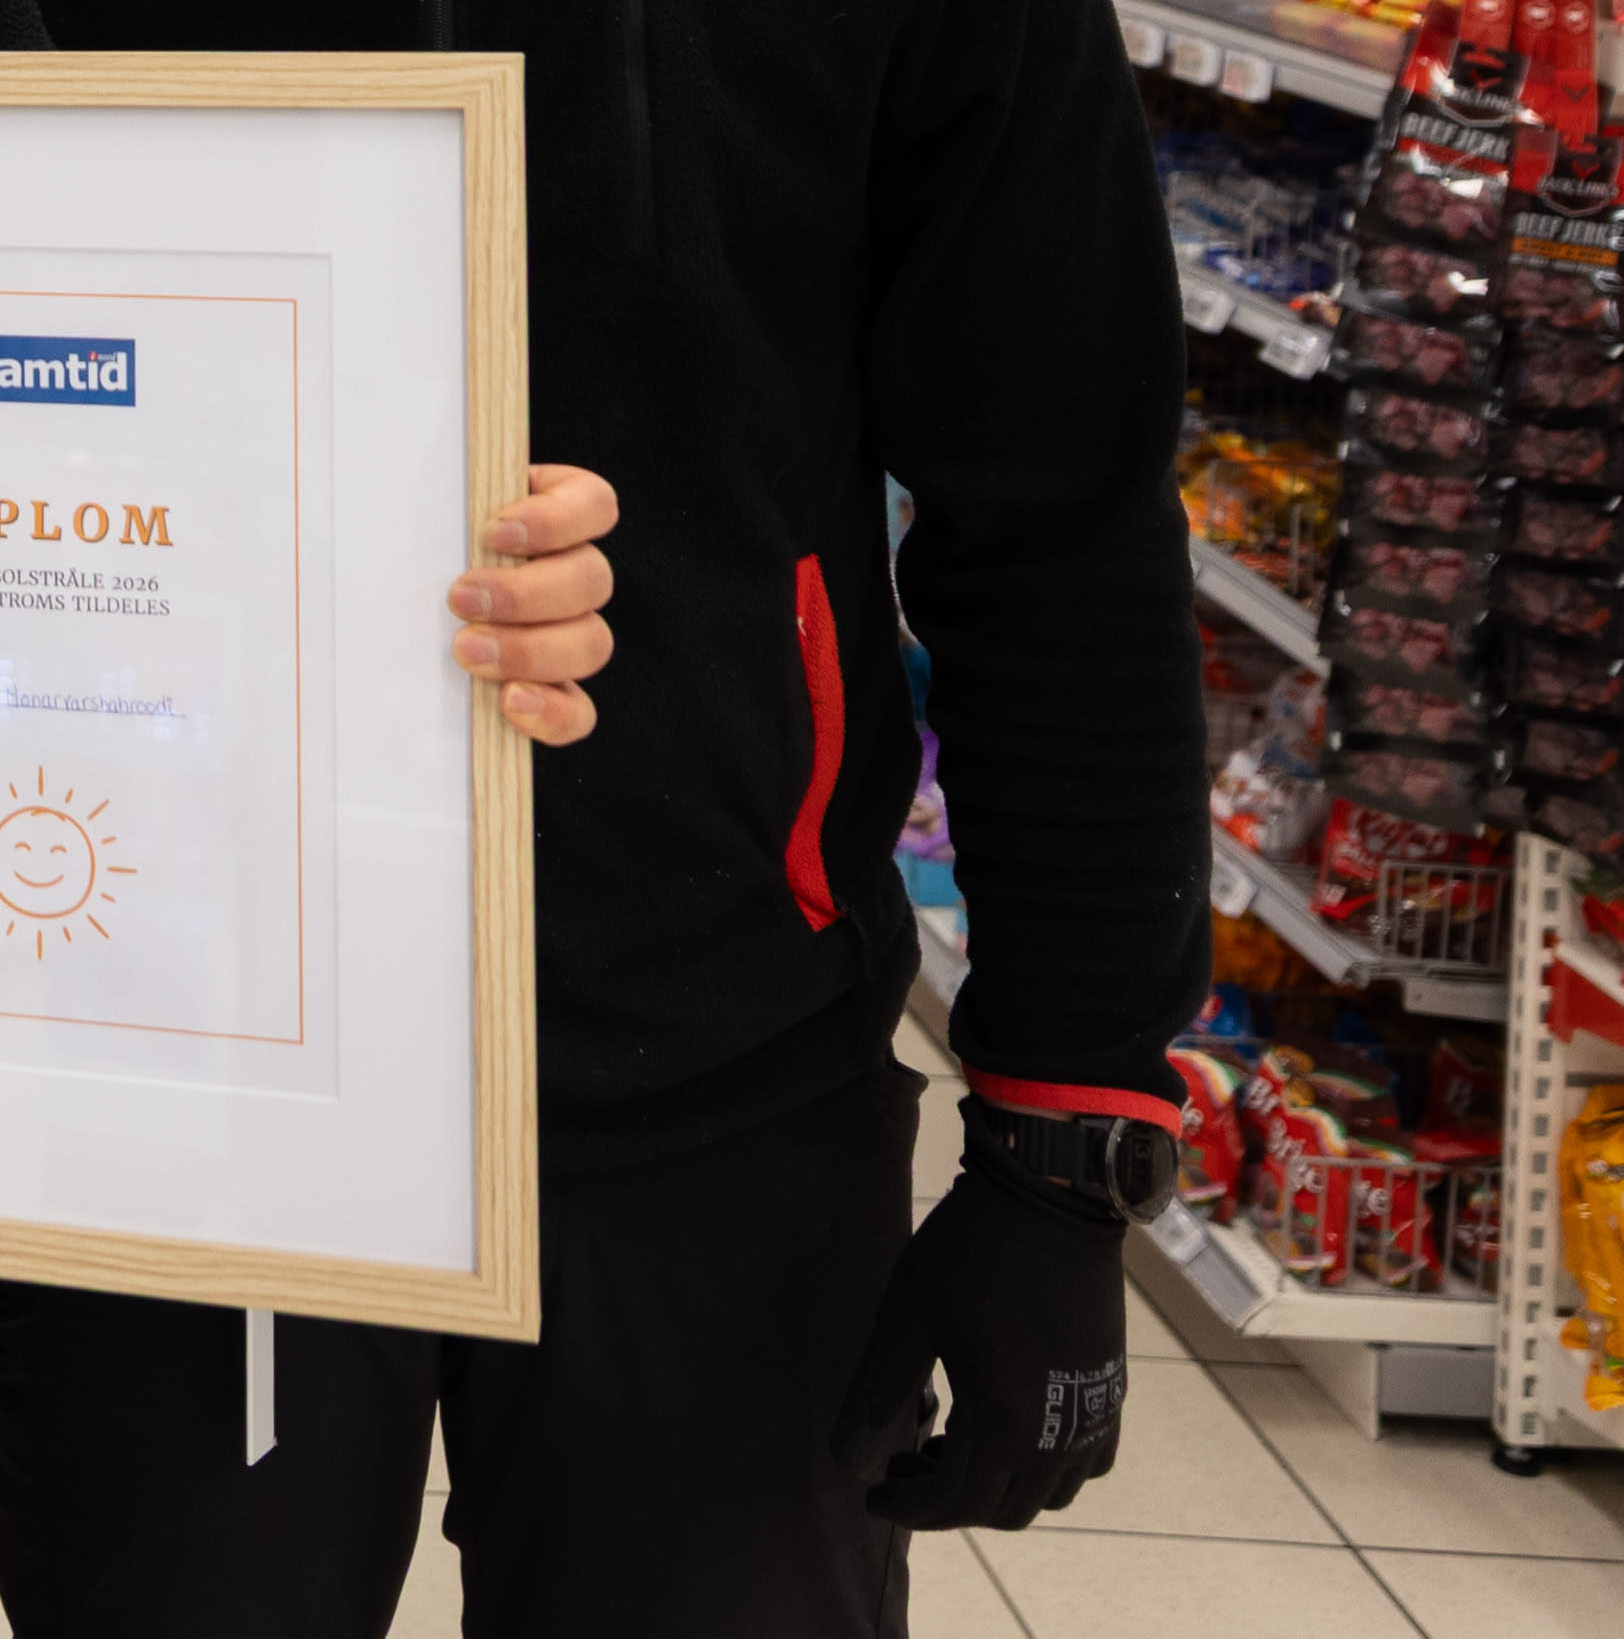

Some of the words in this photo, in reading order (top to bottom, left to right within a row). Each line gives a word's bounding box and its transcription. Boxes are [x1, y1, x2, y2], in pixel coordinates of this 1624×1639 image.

[111, 575, 160, 593] 2026
[71, 594, 171, 617] TILDELES
[1038, 1383, 1065, 1450] GUIDE
